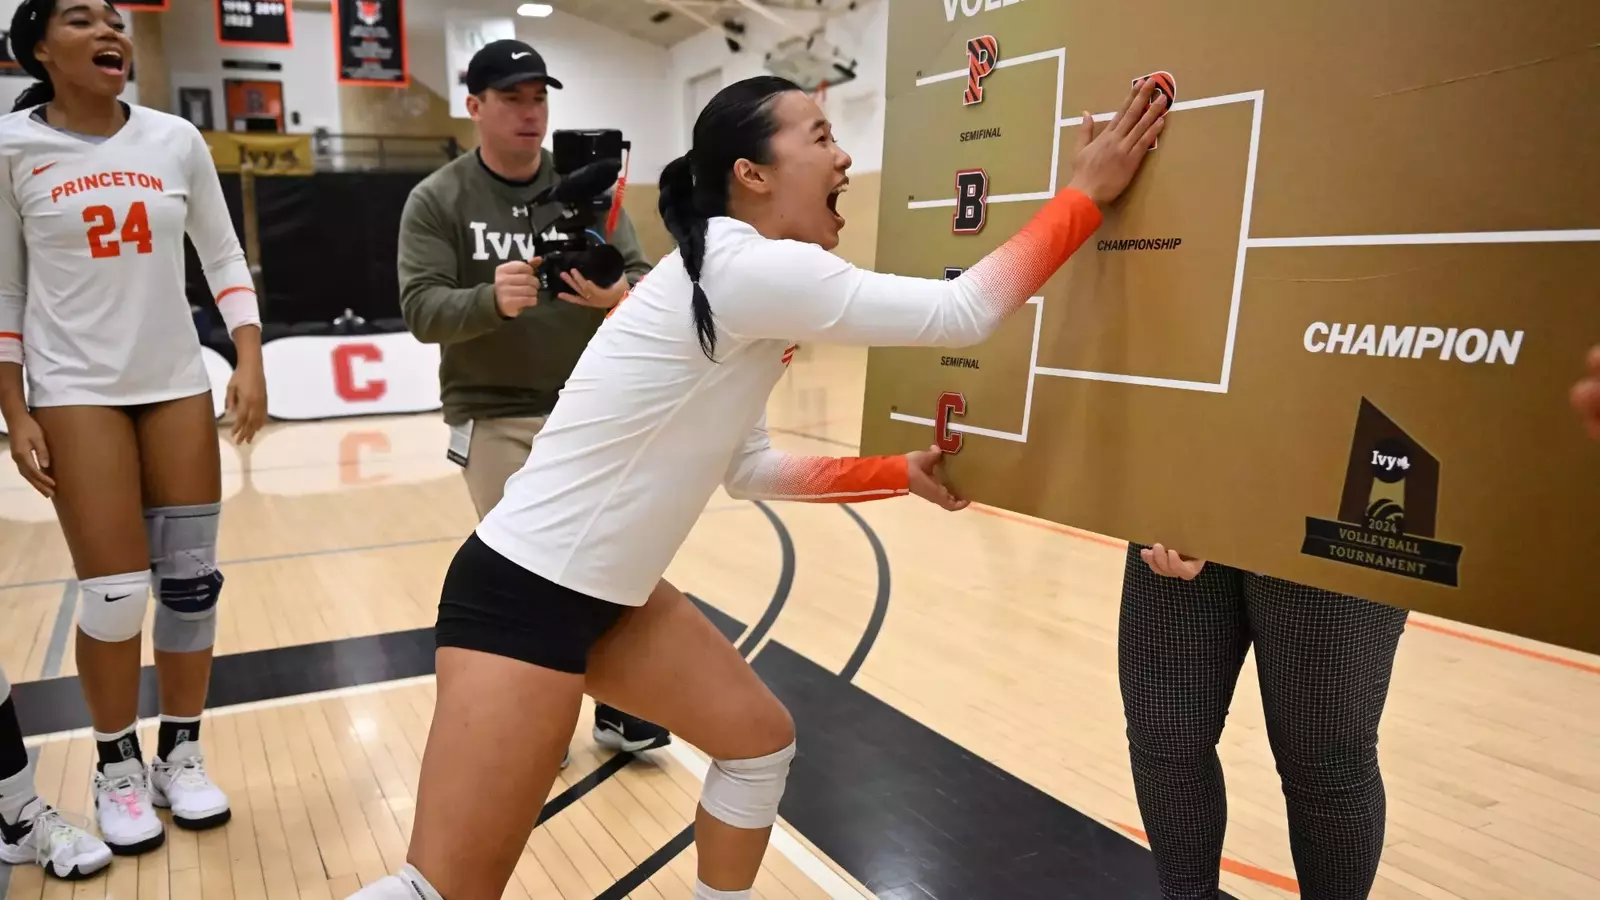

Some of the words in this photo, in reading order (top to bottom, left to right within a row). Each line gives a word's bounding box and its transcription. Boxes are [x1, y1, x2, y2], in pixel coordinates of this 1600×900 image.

[963, 35, 998, 106] P
[959, 128, 1001, 142] SEMIFINAL
[51, 171, 164, 203] PRINCETON
[953, 168, 989, 234] B
[82, 201, 153, 259] 24
[1097, 238, 1182, 252] CHAMPIONSHIP
[1303, 321, 1525, 365] CHAMPION
[331, 343, 387, 402] C
[940, 356, 980, 369] SEMIFINAL
[936, 392, 966, 455] C
[1371, 450, 1397, 471] Ivy
[1339, 528, 1421, 555] VOLLEYBALL
[1368, 518, 1397, 534] 2024
[1329, 544, 1427, 576] TOURNAMENT
